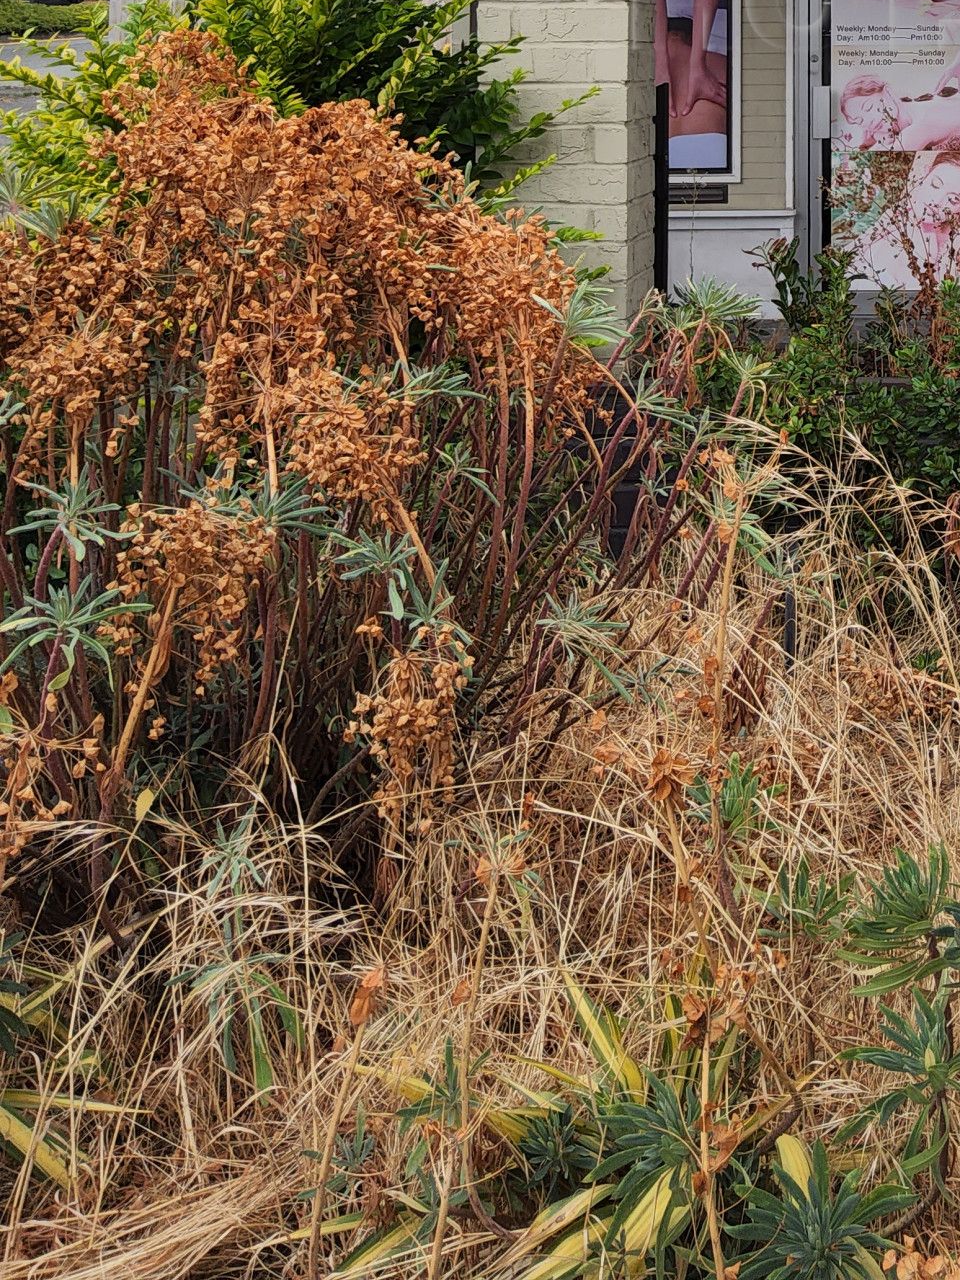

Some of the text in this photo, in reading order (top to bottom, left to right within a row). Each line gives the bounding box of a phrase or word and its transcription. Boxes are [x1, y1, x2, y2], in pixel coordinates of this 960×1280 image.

[836, 24, 866, 33] Weekly:
[836, 34, 854, 42] Day:
[838, 49, 868, 58] Weekly:
[838, 59, 856, 67] Day:
